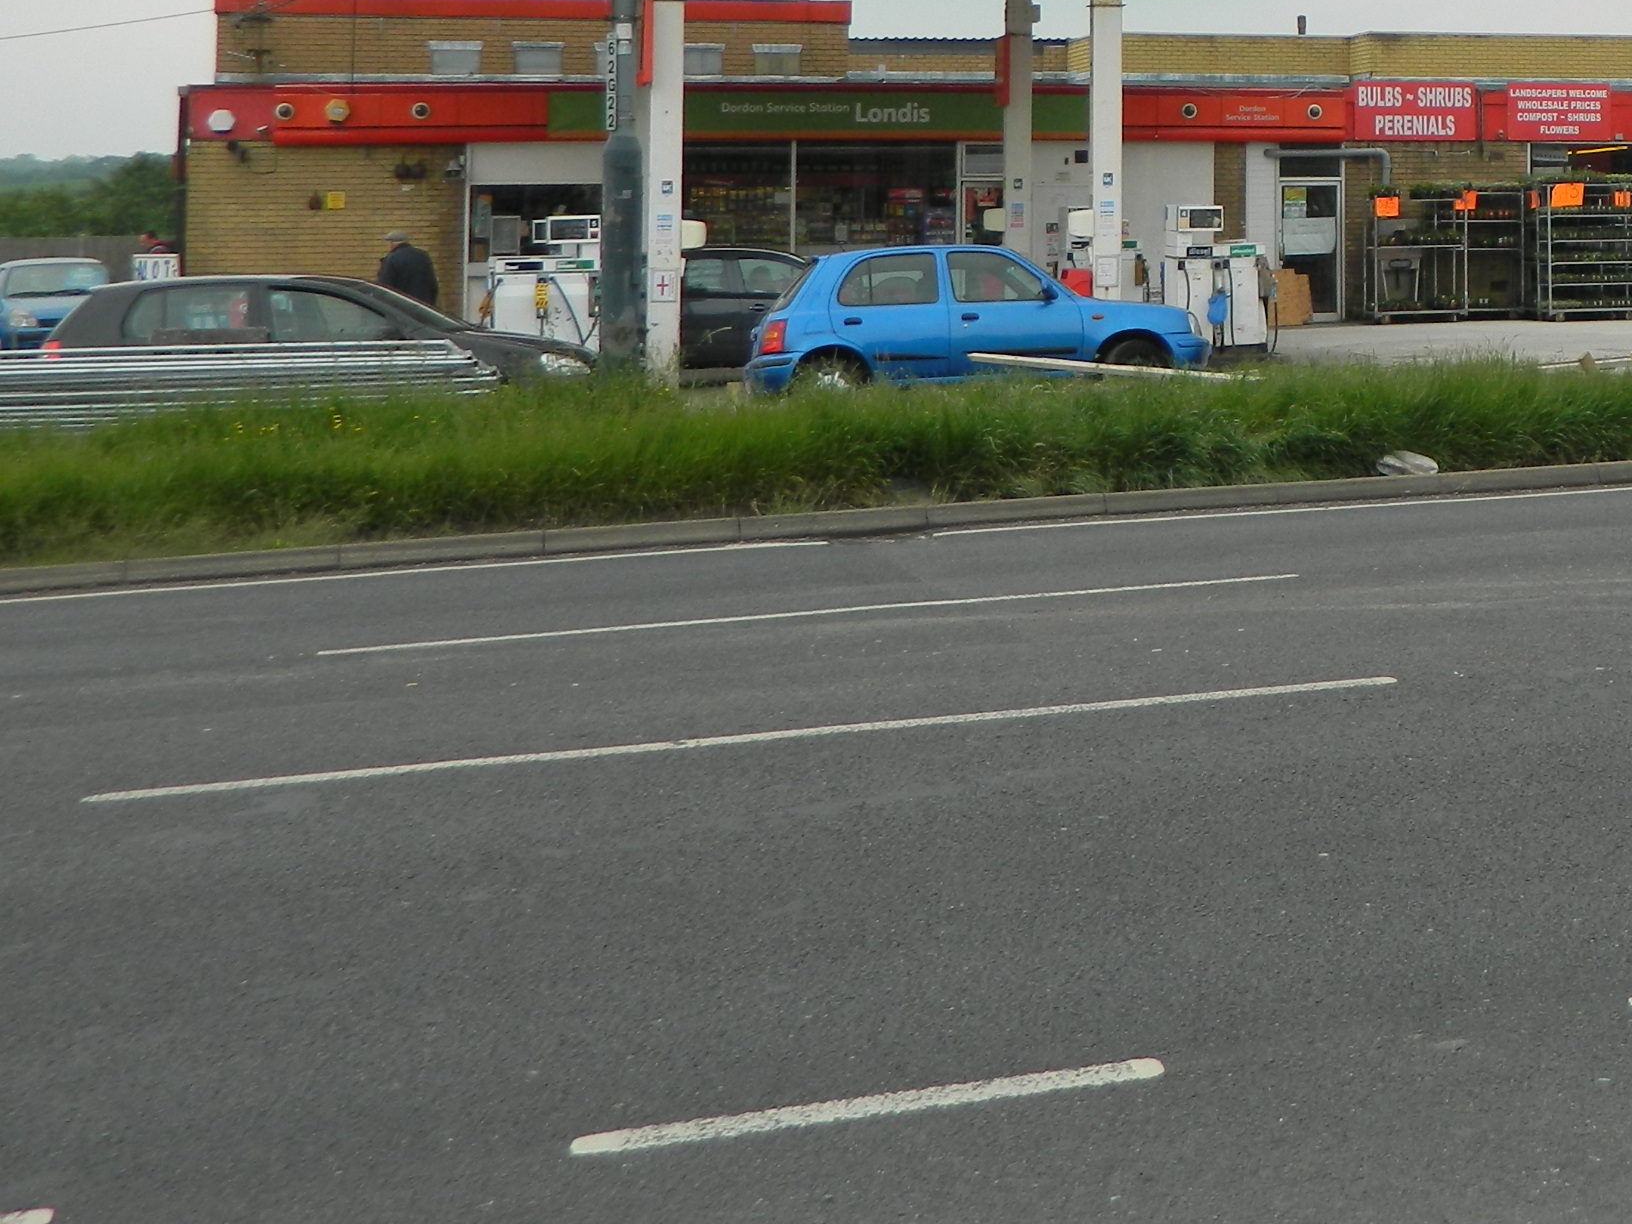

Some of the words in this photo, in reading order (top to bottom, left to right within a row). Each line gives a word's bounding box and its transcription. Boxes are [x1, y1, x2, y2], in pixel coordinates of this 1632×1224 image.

[1358, 86, 1402, 107] BULBS
[1417, 86, 1472, 108] SHRUBS
[1510, 88, 1567, 98] LANDSCAPERS
[1568, 89, 1608, 99] WELCOME
[721, 102, 763, 113] Dordon
[766, 102, 806, 113] Service
[809, 102, 850, 114] Station
[1517, 100, 1569, 110] WHOLESALE
[1570, 100, 1601, 110] PRICES
[855, 102, 931, 123] Londis
[1517, 112, 1558, 122] COMPOST
[1567, 112, 1602, 122] SHRUBS
[1375, 115, 1456, 136] PERENIALS
[1539, 125, 1580, 135] FLOWERS
